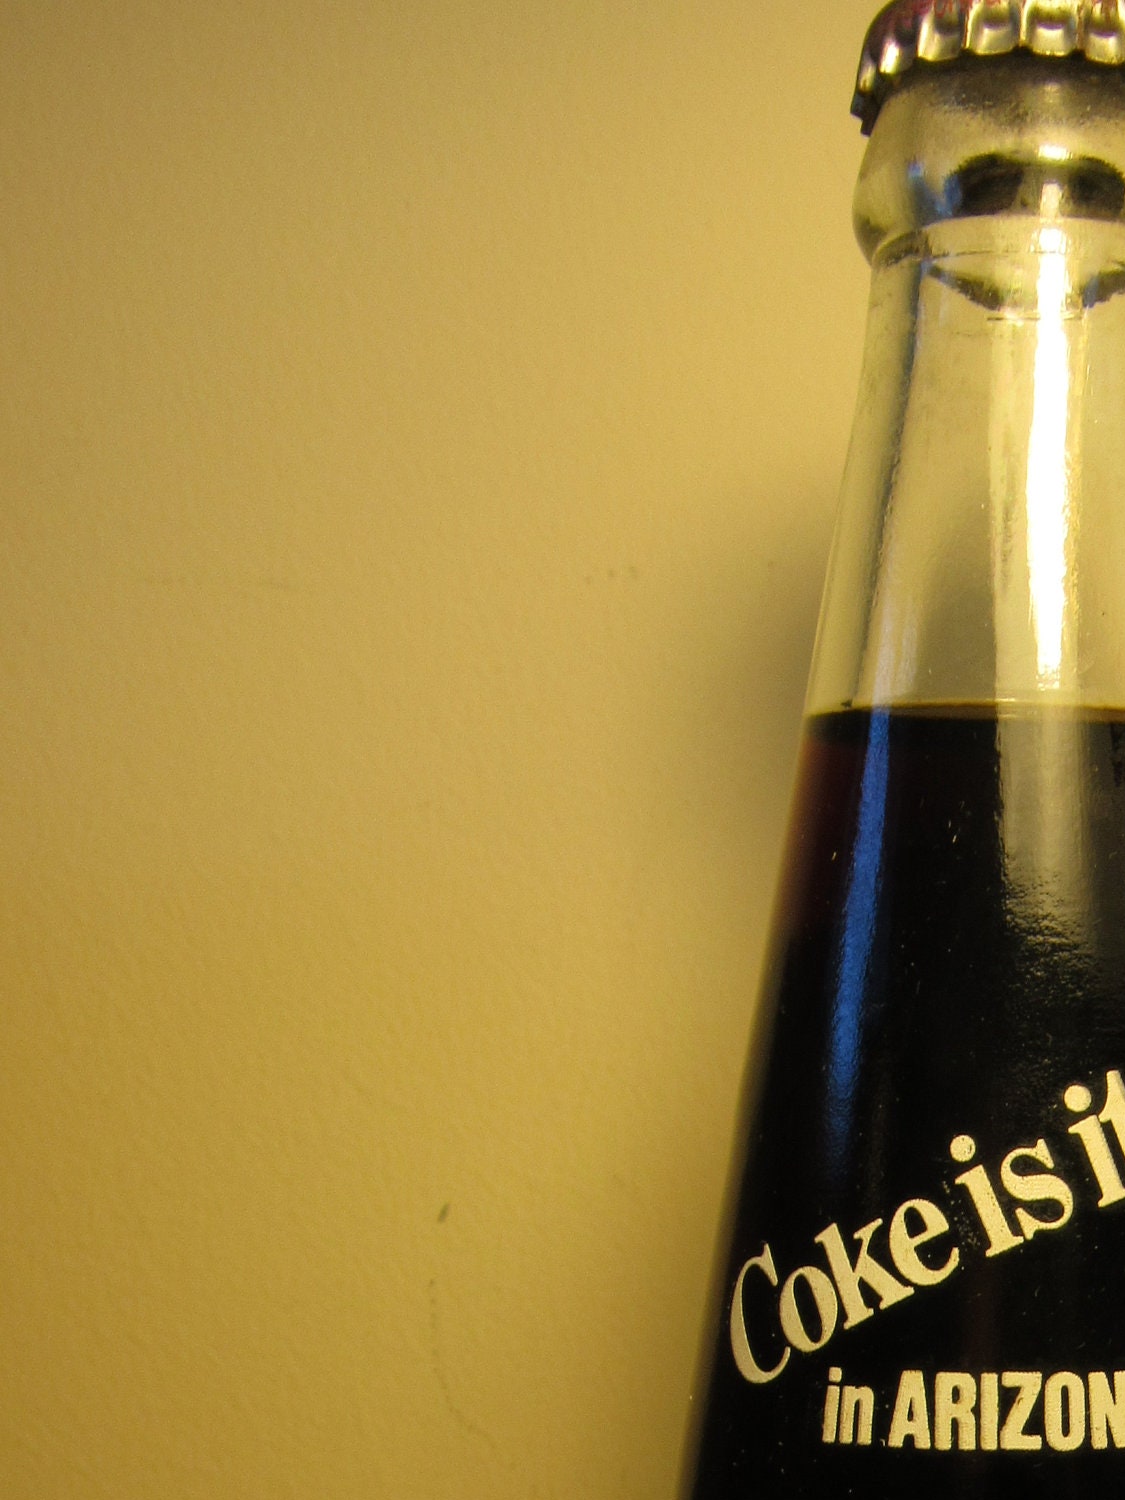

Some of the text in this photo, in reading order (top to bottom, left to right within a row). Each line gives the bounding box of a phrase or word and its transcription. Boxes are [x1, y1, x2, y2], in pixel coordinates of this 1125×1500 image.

[729, 1198, 960, 1384] Coke
[949, 1134, 1074, 1257] is
[822, 1366, 875, 1445] in
